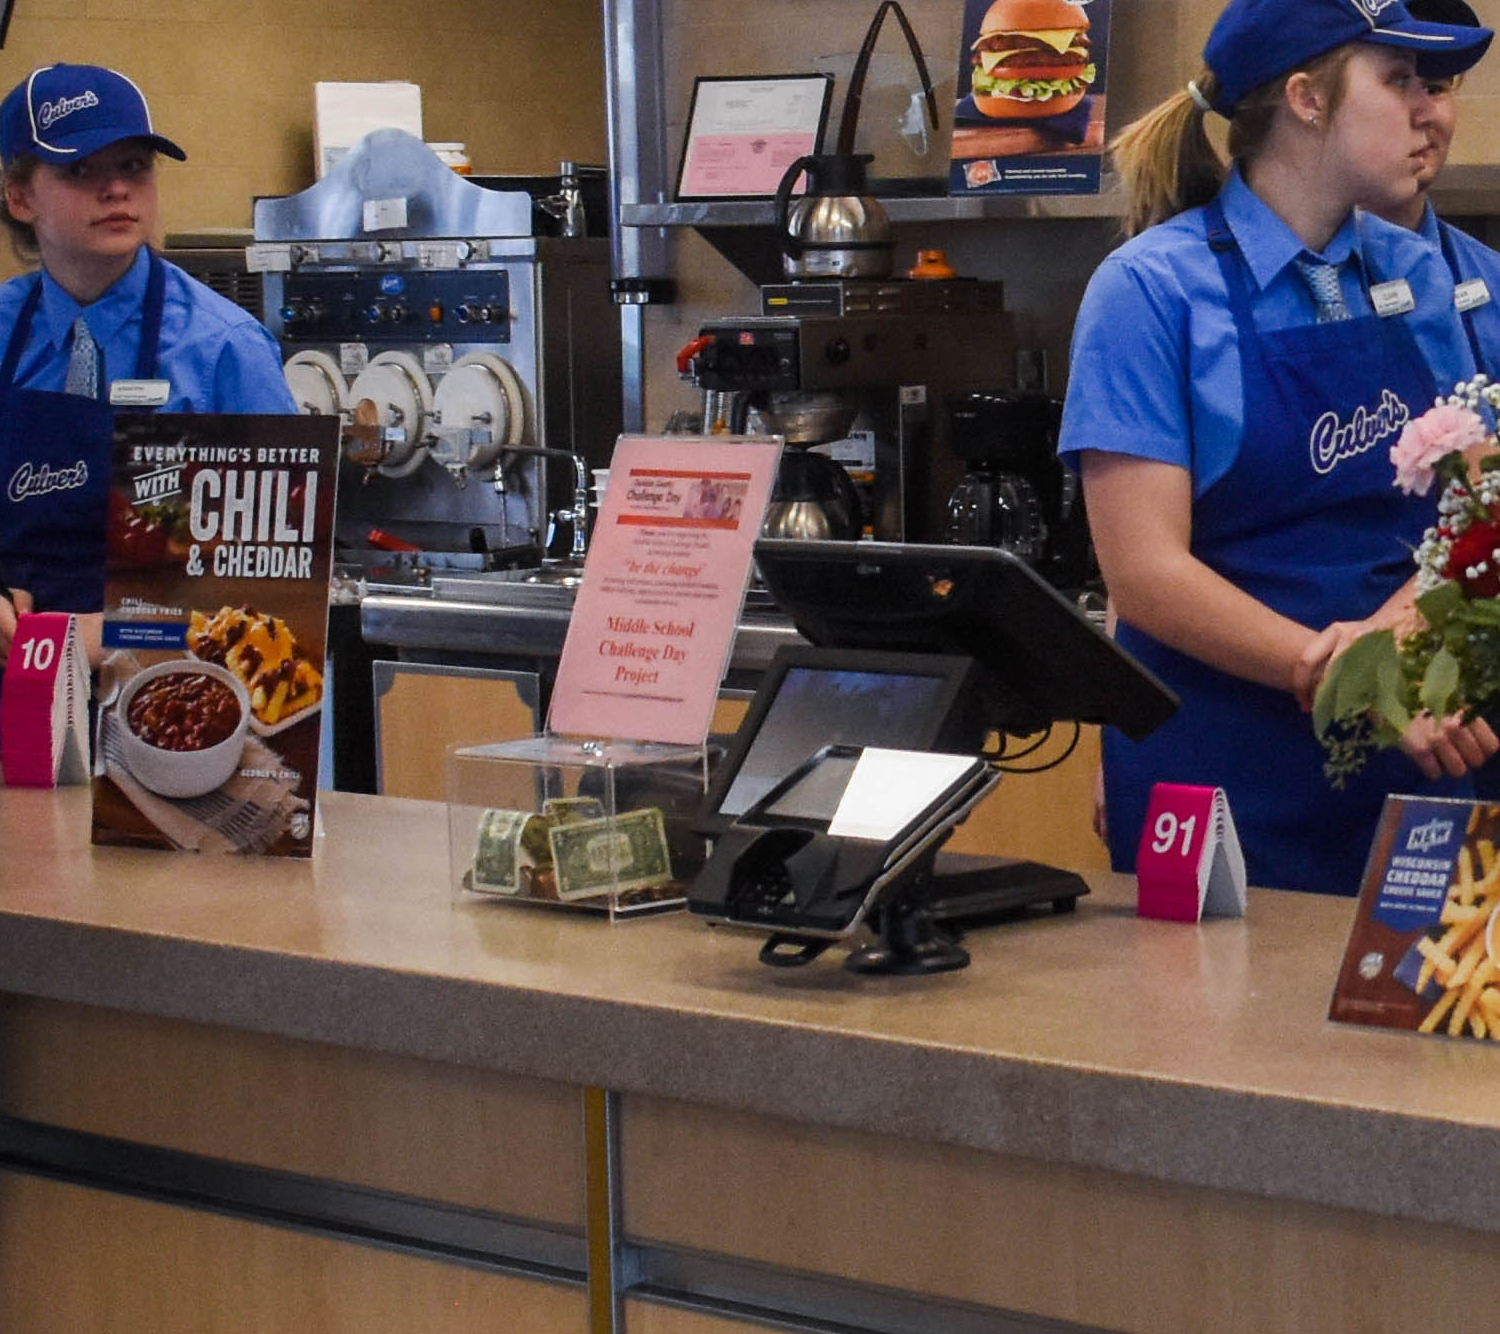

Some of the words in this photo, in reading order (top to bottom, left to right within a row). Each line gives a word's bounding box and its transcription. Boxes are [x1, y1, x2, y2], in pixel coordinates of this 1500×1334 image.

[38, 91, 98, 129] Culver's
[1311, 389, 1409, 473] Culver's
[133, 446, 251, 463] EVERYTHING'S
[257, 448, 320, 463] BETTER
[7, 461, 88, 502] Culver's
[627, 488, 662, 503] Challenge
[665, 491, 681, 506] Day
[133, 472, 180, 498] WITH
[189, 469, 317, 543] CHILI
[186, 545, 202, 576] &
[214, 546, 312, 579] CHEDDAR
[607, 616, 650, 636] Middle
[653, 620, 695, 639] School
[21, 638, 55, 671] 10
[599, 640, 660, 661] Challenge
[663, 645, 689, 665] Day
[615, 667, 658, 685] Project
[1152, 812, 1196, 856] 91
[1387, 869, 1447, 888] CHEDDAR
